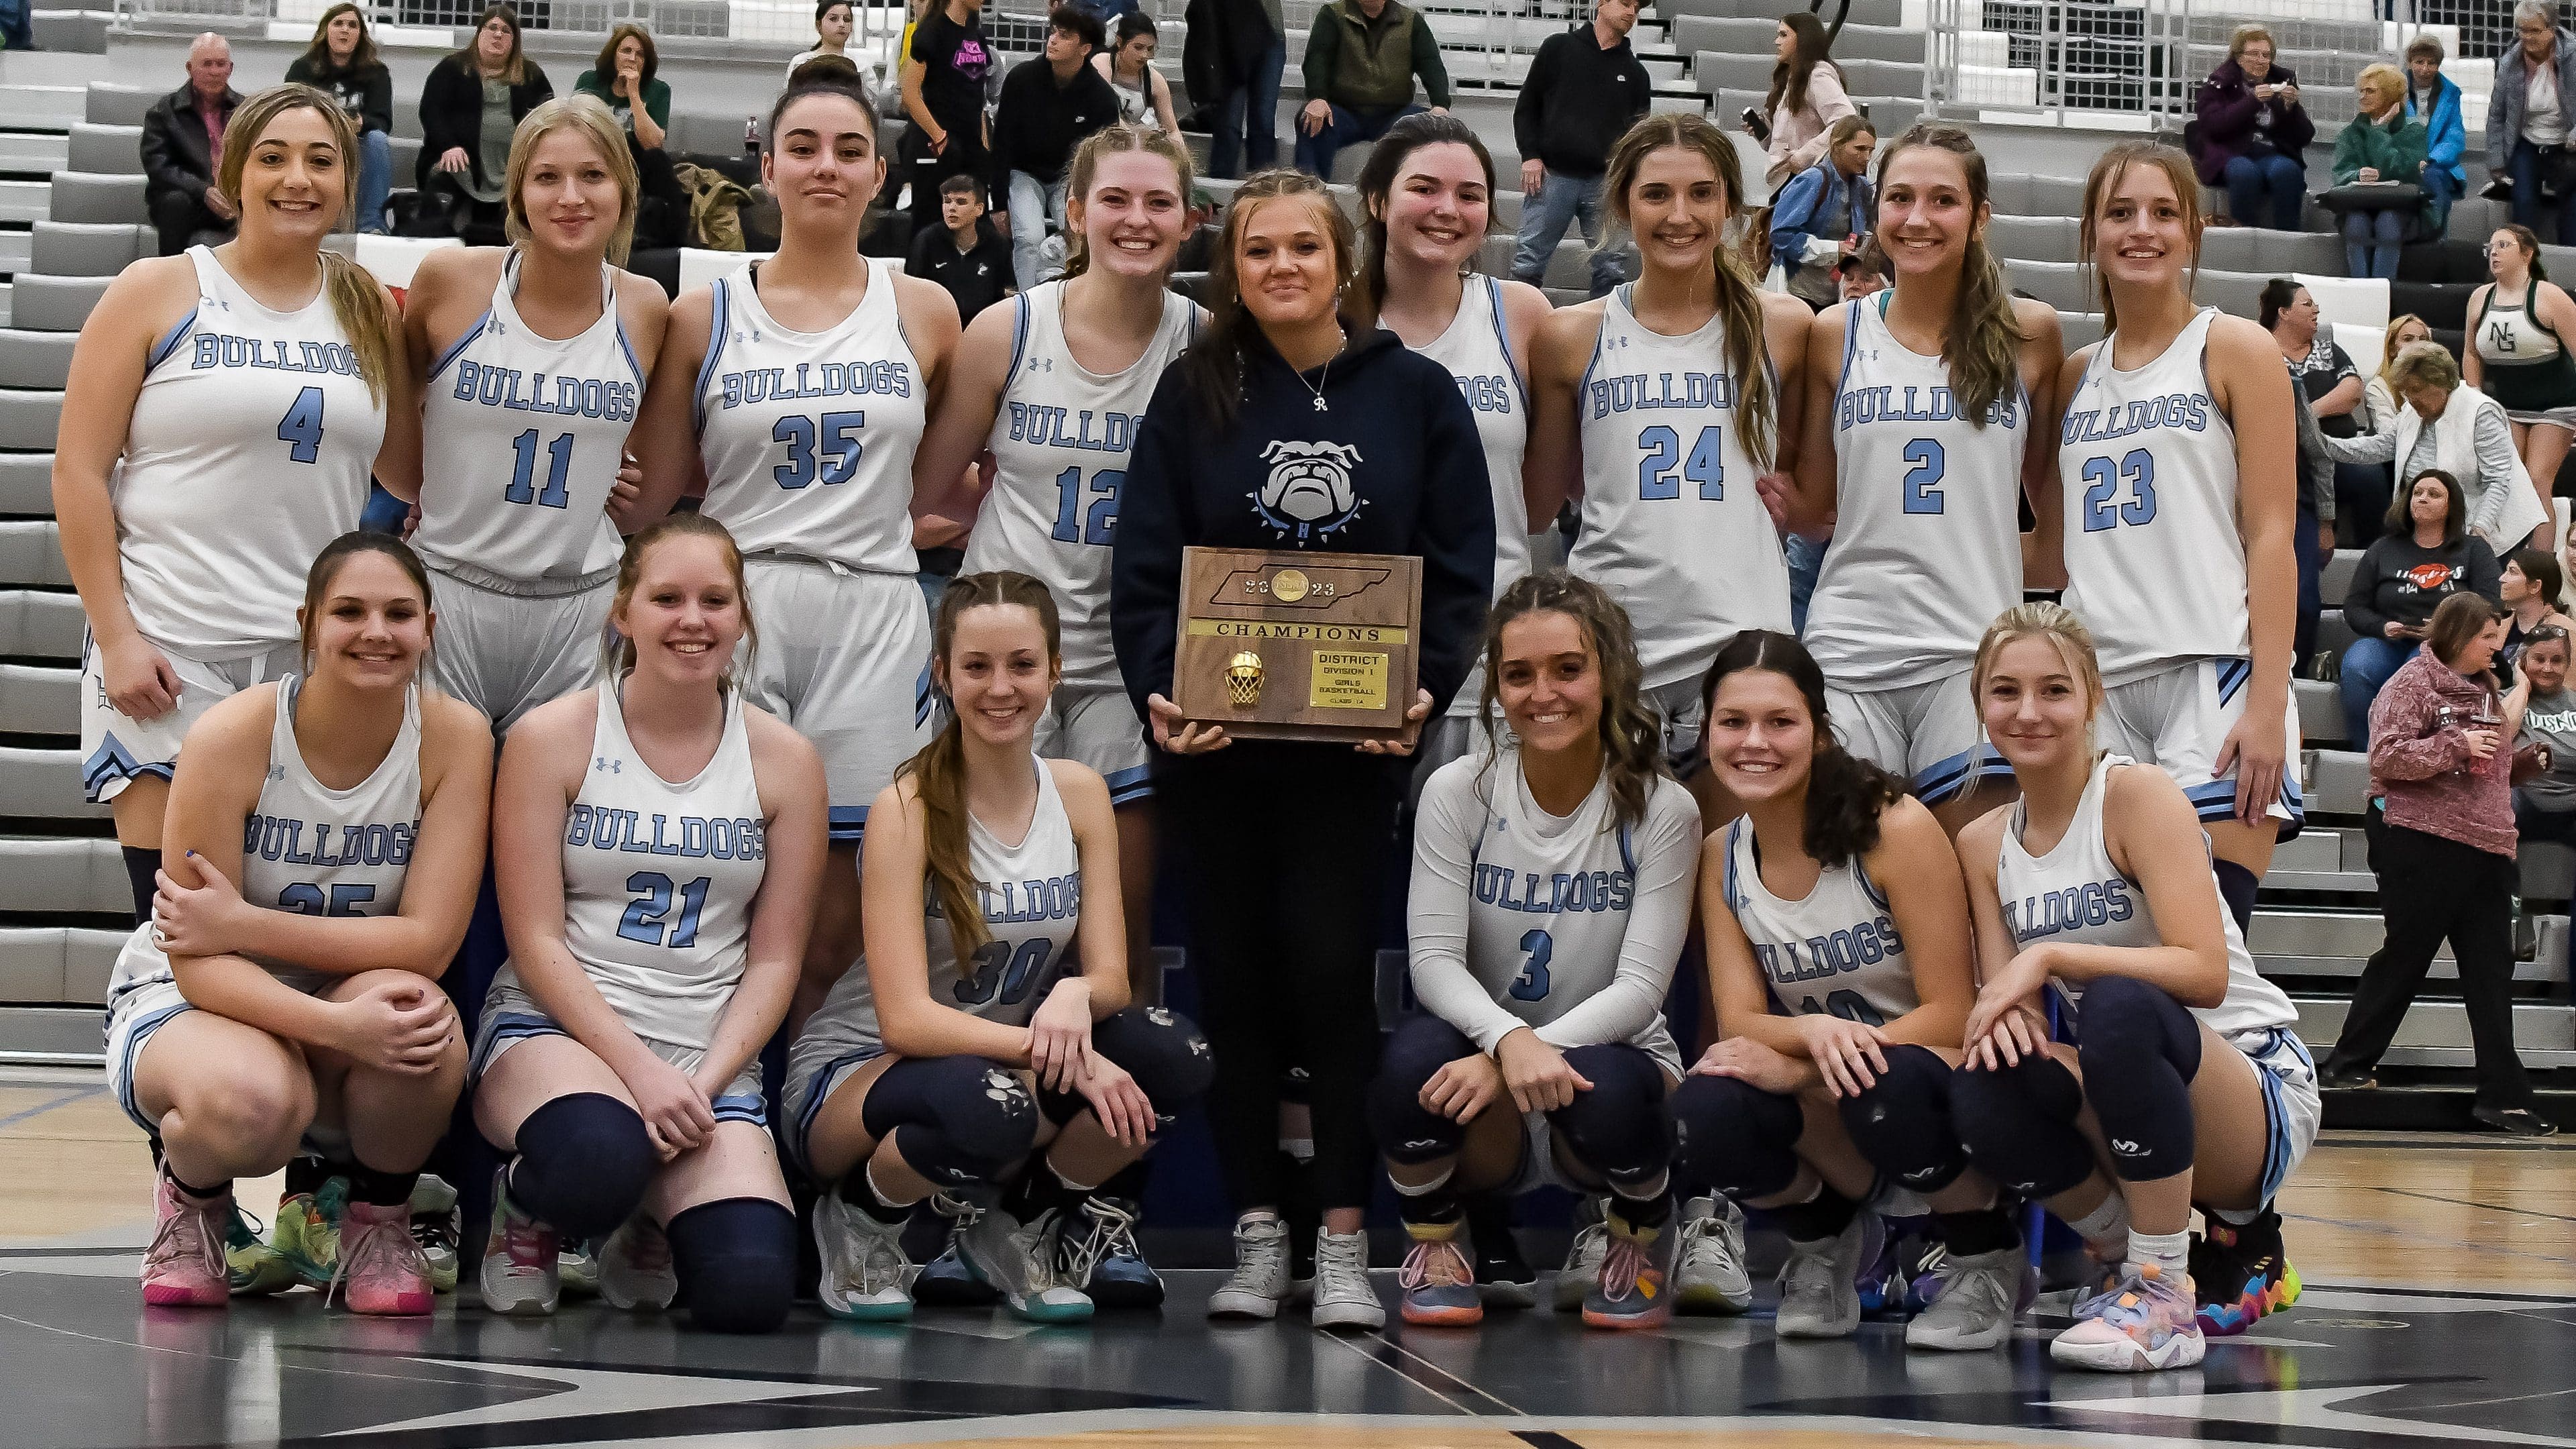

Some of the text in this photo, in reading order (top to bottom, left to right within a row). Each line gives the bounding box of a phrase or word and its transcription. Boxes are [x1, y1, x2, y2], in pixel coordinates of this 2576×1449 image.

[191, 333, 366, 380] BULLDOG
[722, 360, 911, 411] BULLDOGS
[453, 359, 635, 423] BULLDOGS
[1590, 372, 1739, 420] BULLDO
[2062, 393, 2208, 446] ULLDOGS
[277, 386, 324, 464] 4
[772, 410, 865, 490] 35
[504, 428, 576, 510] 11
[1638, 425, 1725, 502] 24
[1902, 437, 1945, 515] 2
[2081, 447, 2157, 533] 23
[1051, 465, 1128, 545] 12
[1245, 580, 1269, 594] 20
[1311, 582, 1335, 596] 23
[1216, 623, 1381, 642] CHAMPIONS
[1319, 653, 1380, 665] DISTRICT
[1319, 687, 1377, 696] BASKETBALL
[1323, 667, 1364, 676] DIVISION
[1335, 679, 1361, 687] GIRLS
[567, 803, 765, 861] BULLDOGS
[616, 870, 712, 949] 21
[1476, 863, 1635, 914] ULLDOGS
[953, 938, 1053, 1006] 30
[1507, 928, 1553, 1002] 3
